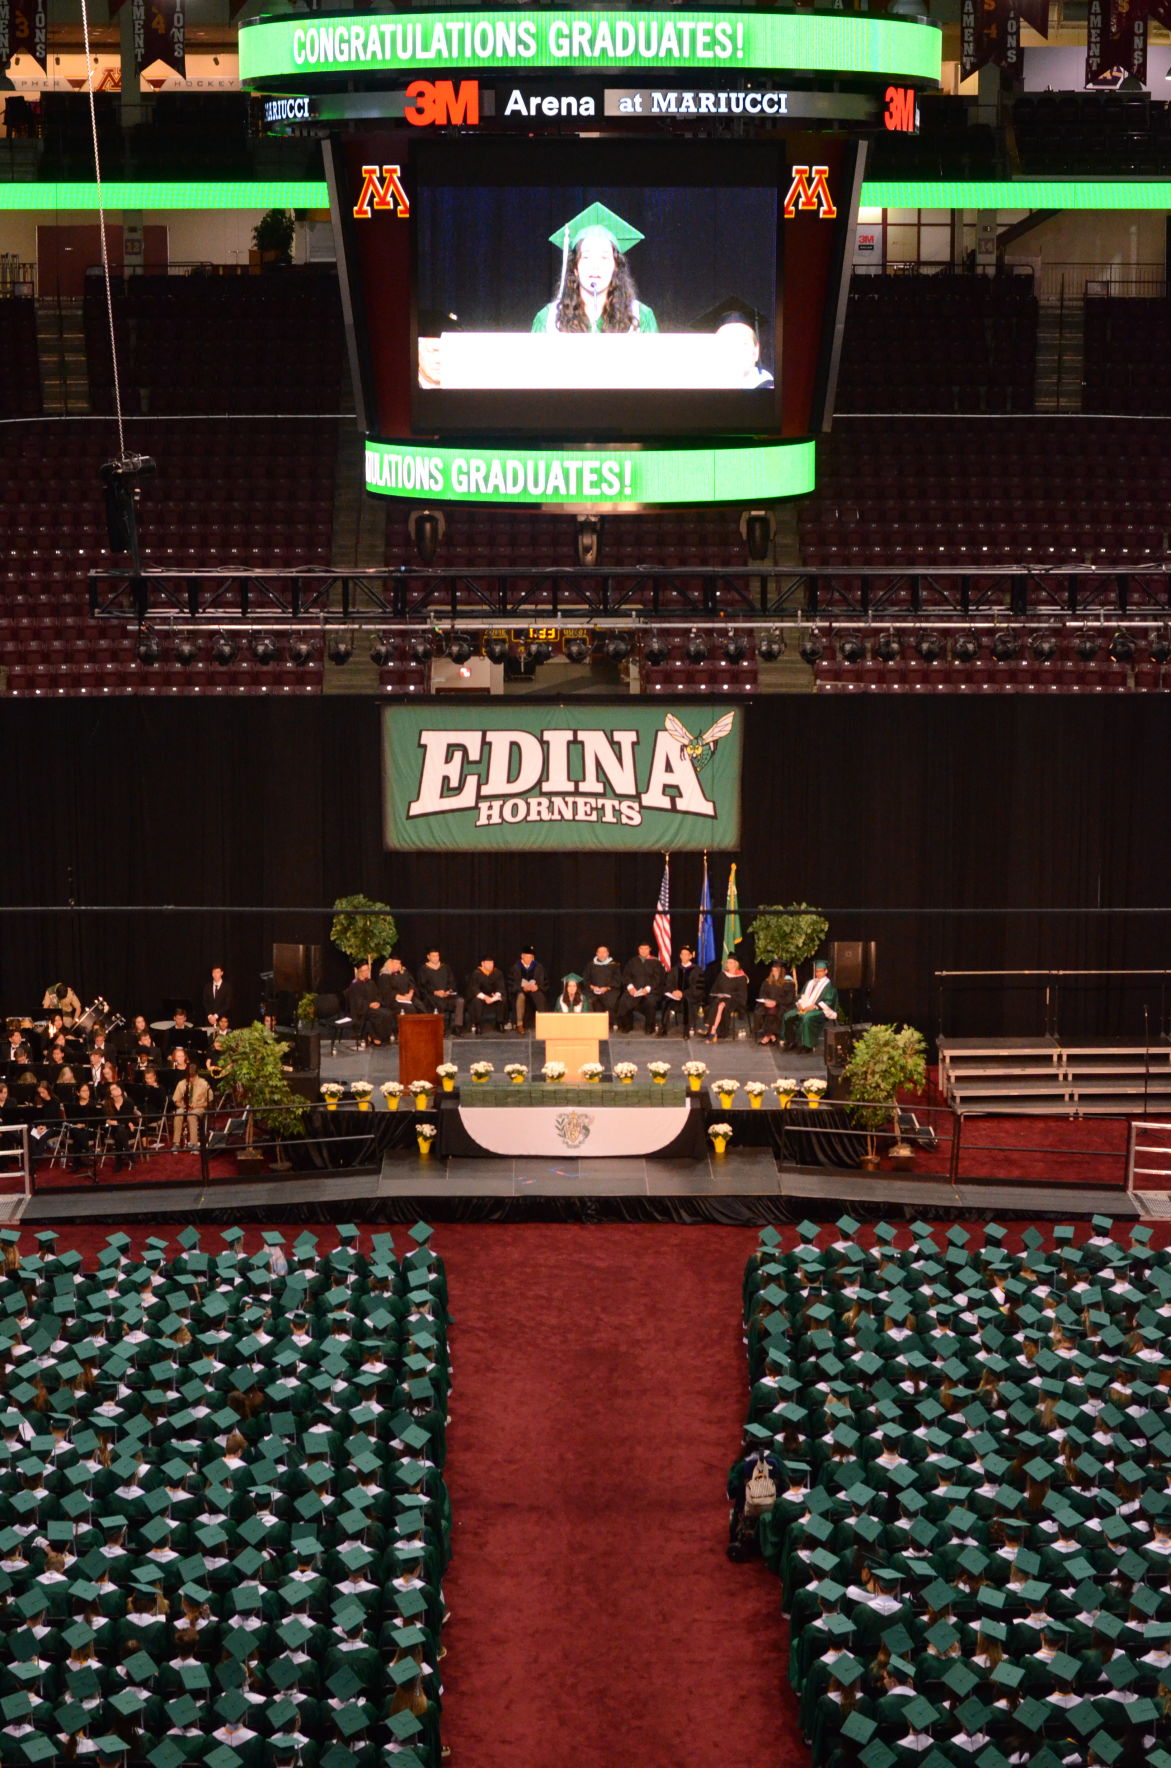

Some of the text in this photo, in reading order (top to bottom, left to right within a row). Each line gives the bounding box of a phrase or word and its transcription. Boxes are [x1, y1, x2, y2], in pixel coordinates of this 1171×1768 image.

[293, 20, 744, 64] CONGRATULATIONS GRADUATES!
[404, 80, 788, 126] 3M Arena at MARIUCCI
[884, 86, 915, 132] 3M
[353, 165, 410, 218] M
[784, 166, 837, 218] M
[451, 458, 633, 496] GRADUATES!
[406, 729, 717, 820] EDINA
[475, 796, 643, 828] HORNETS
